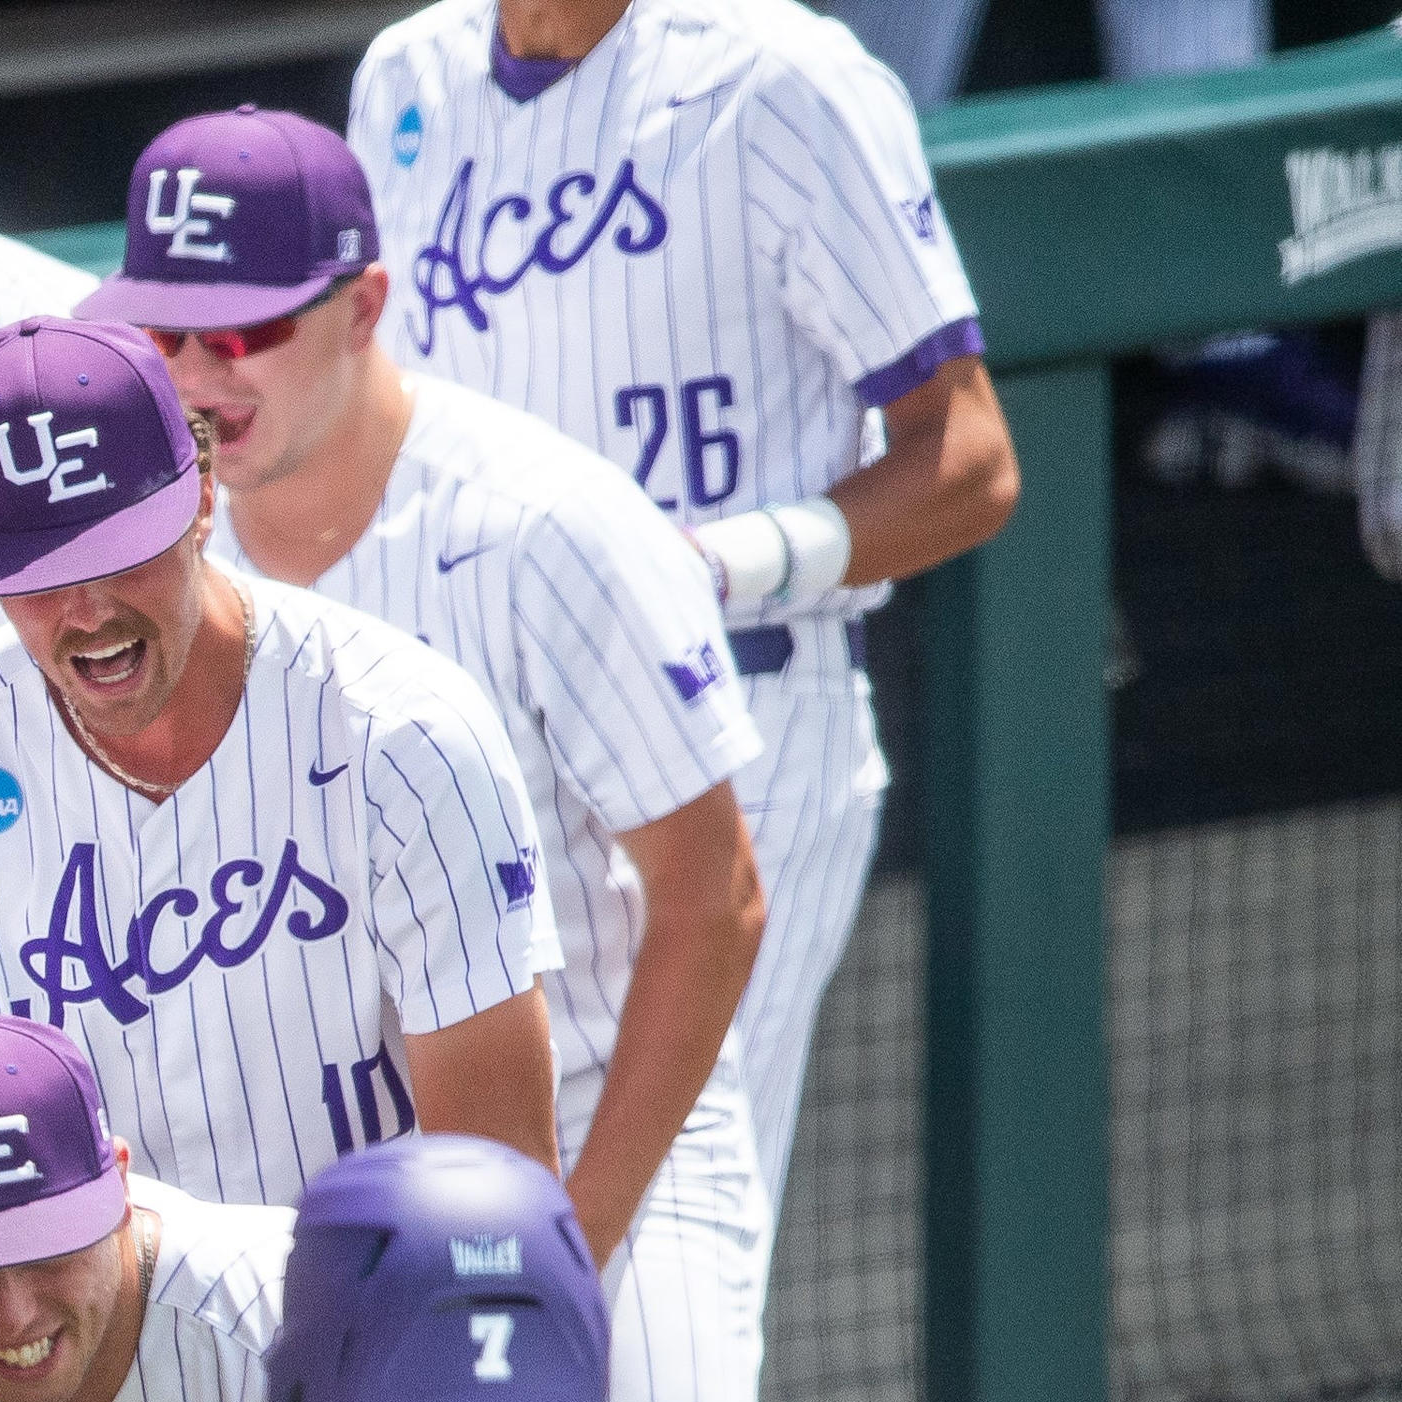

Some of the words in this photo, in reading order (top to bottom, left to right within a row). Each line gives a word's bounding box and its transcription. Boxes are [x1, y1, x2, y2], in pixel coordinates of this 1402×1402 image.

[146, 168, 235, 260] UE
[617, 376, 740, 510] 26
[469, 1313, 514, 1379] 7
